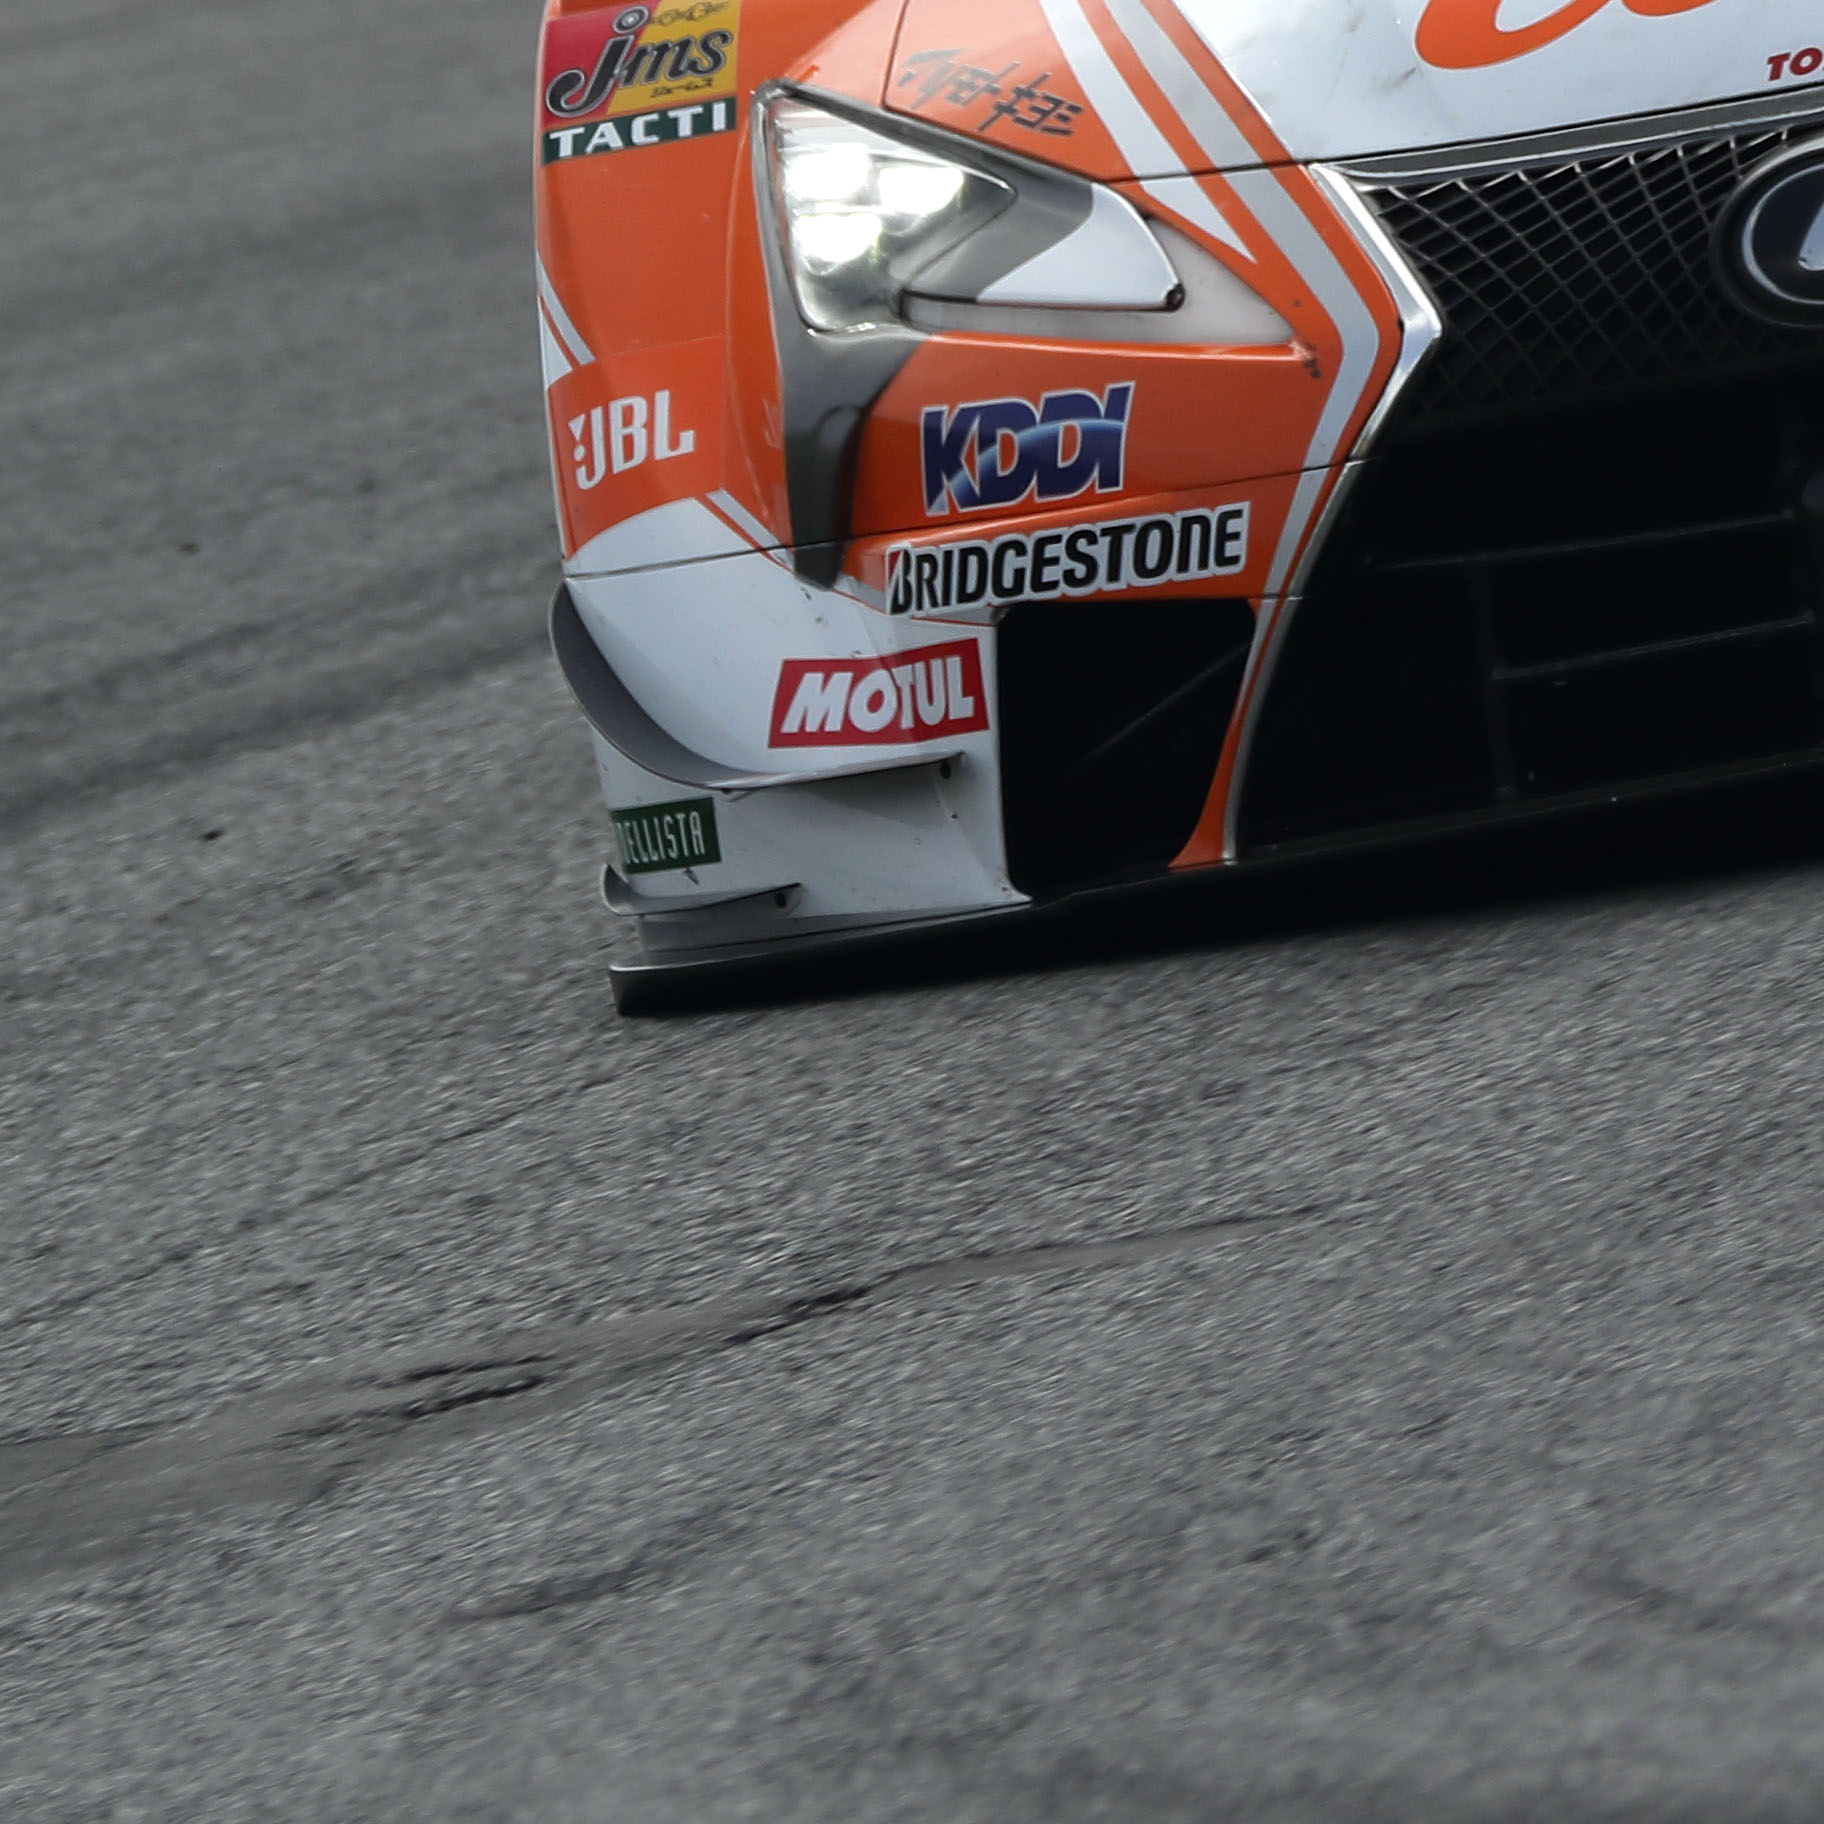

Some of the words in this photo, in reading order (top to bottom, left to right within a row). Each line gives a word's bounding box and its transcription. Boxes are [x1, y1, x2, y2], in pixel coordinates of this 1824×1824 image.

[545, 5, 734, 119] jms
[549, 101, 728, 159] TACTI
[567, 389, 696, 491] JBL
[920, 380, 1136, 518] KDDI
[888, 508, 1246, 616] BRIDGESTONE
[779, 654, 976, 735] MOTUL
